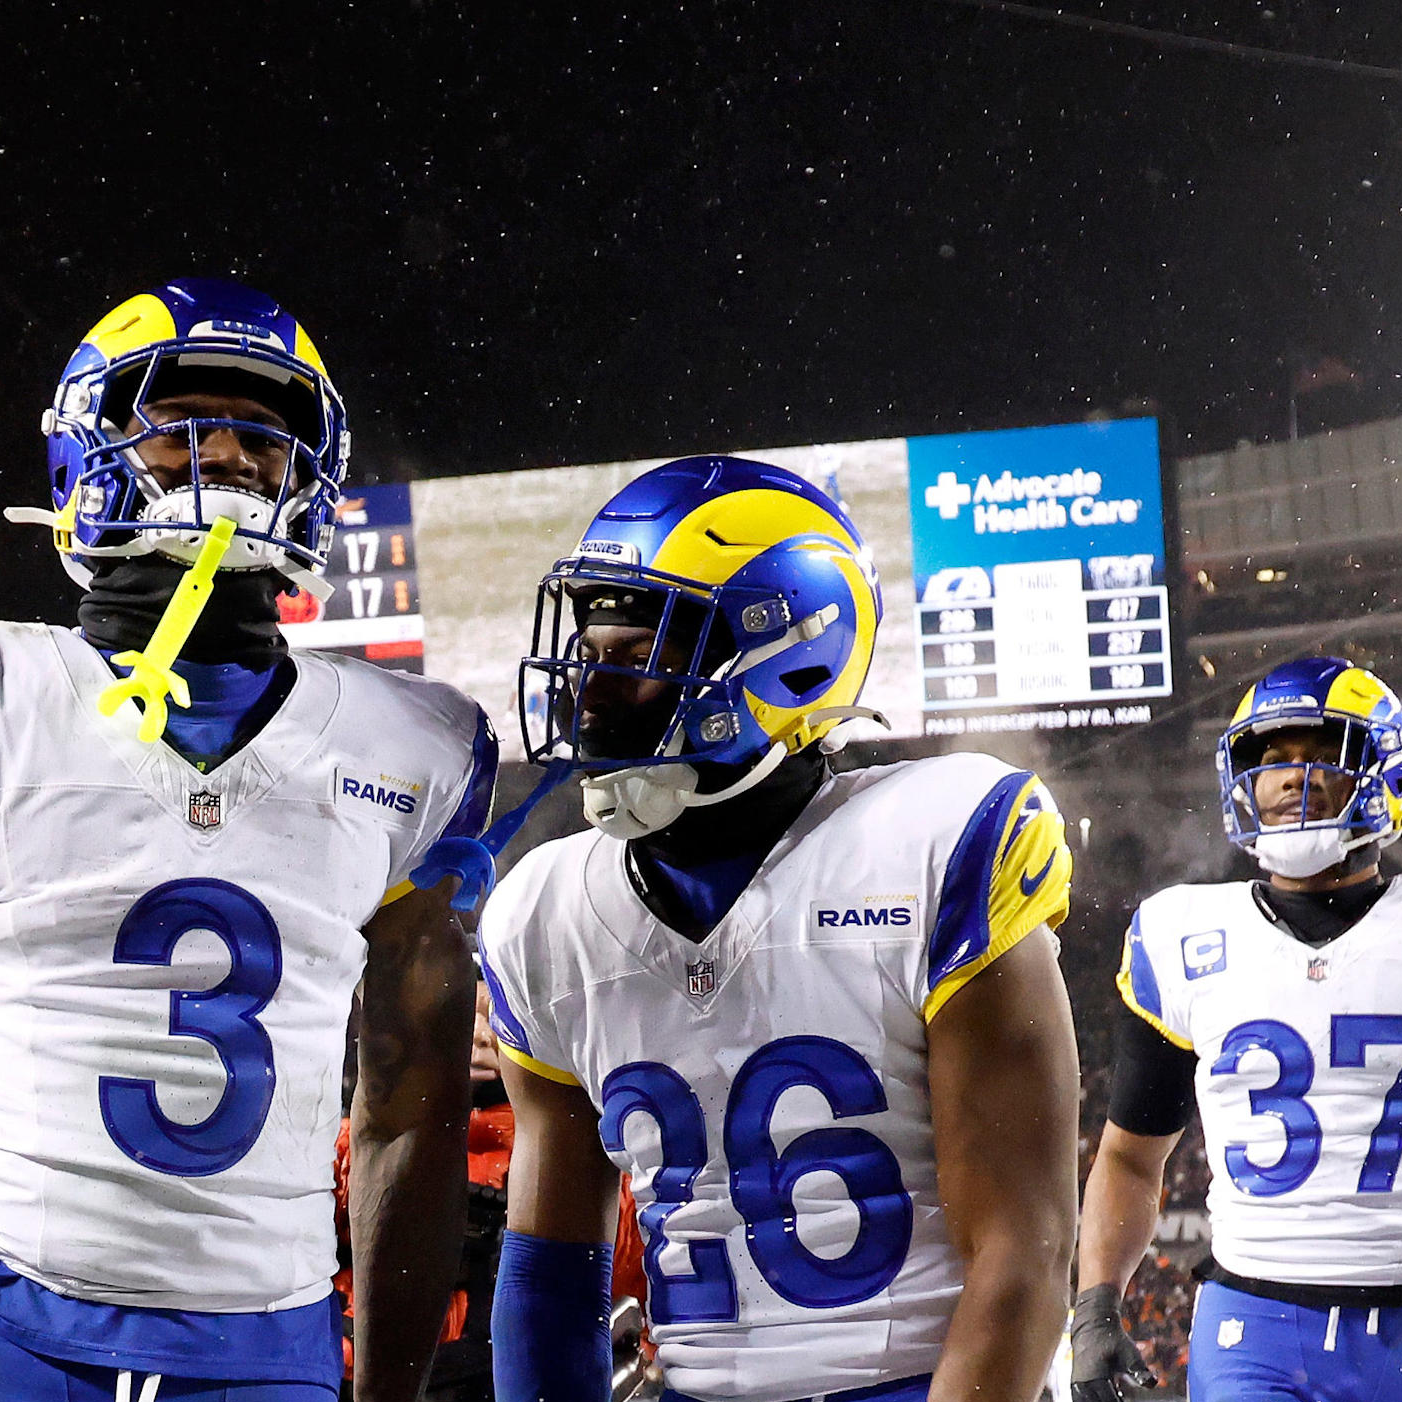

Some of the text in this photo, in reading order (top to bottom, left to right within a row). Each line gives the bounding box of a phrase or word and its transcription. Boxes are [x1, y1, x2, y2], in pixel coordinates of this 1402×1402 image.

[973, 467, 1102, 504] Advocate
[973, 496, 1138, 534] Health Care
[343, 531, 380, 574] 17
[347, 577, 383, 618] 17
[342, 777, 417, 814] RAMS
[191, 805, 218, 824] NFL
[817, 907, 912, 927] RAMS
[690, 973, 713, 994] NFL
[98, 876, 283, 1177] 3
[598, 1034, 914, 1324] 26
